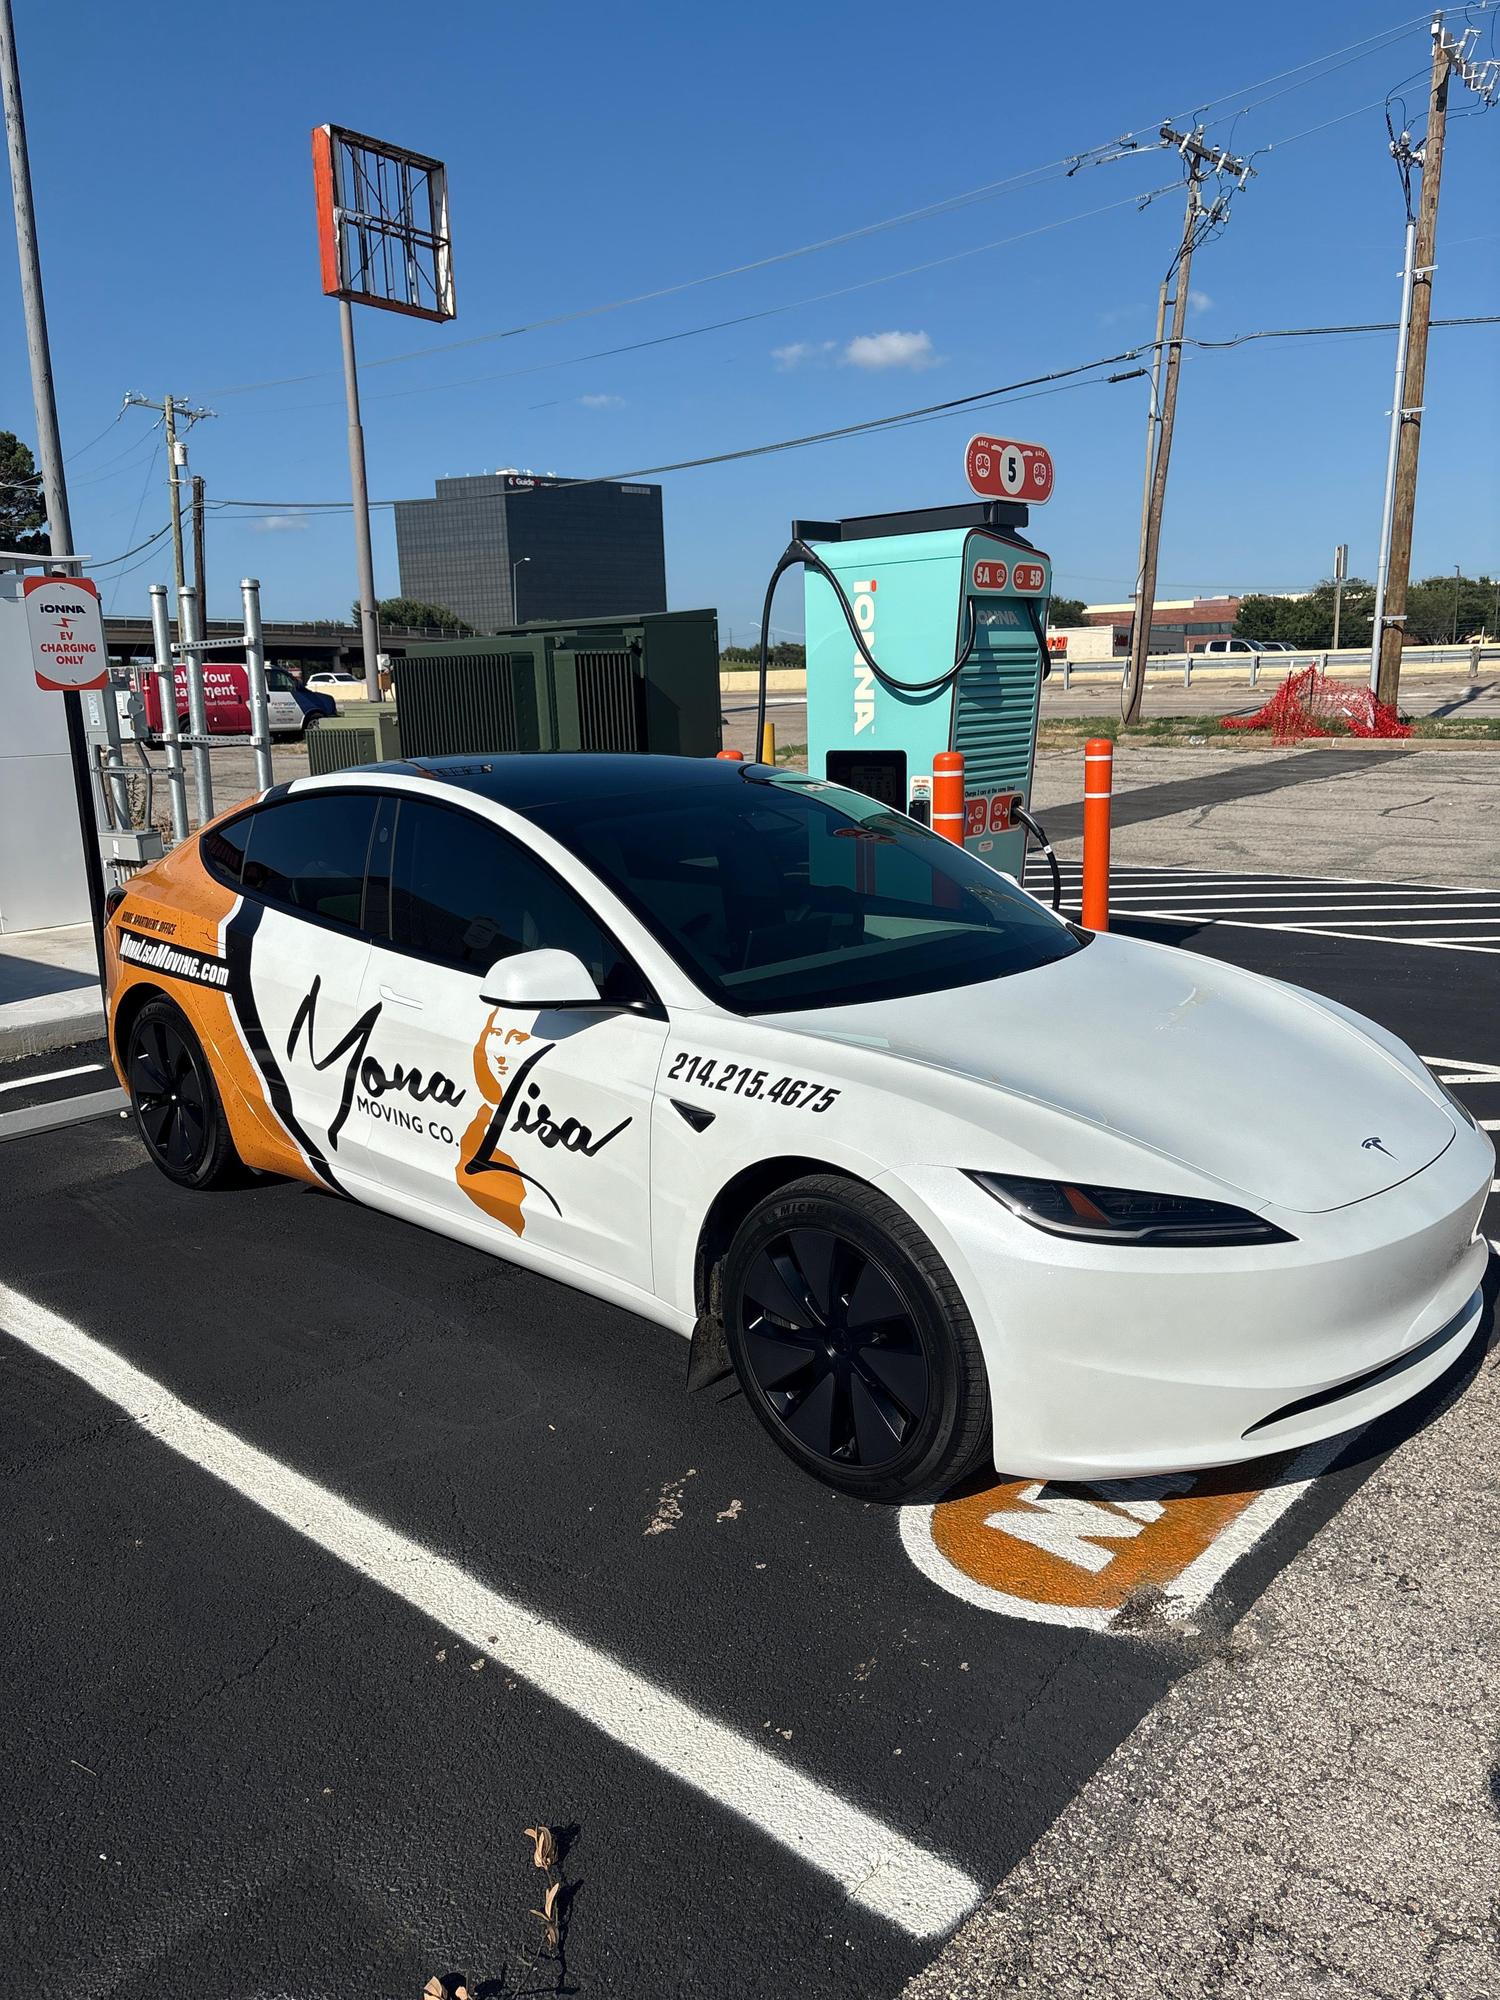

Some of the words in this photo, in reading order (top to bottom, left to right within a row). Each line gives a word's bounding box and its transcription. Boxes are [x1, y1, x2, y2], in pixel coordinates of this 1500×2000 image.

[1008, 457, 1017, 482] 5
[976, 566, 990, 584] 5A
[1029, 570, 1041, 586] 5B
[976, 610, 1020, 625] ONNA
[60, 632, 73, 640] EV
[40, 643, 96, 653] CHARGING
[56, 655, 84, 665] ONLY
[203, 671, 231, 683] Your
[667, 1052, 842, 1114] 214.215.4675
[286, 974, 466, 1152] Mona
[464, 1043, 634, 1218] Lisa
[356, 1094, 424, 1134] MOVING
[428, 1121, 460, 1147] CO.
